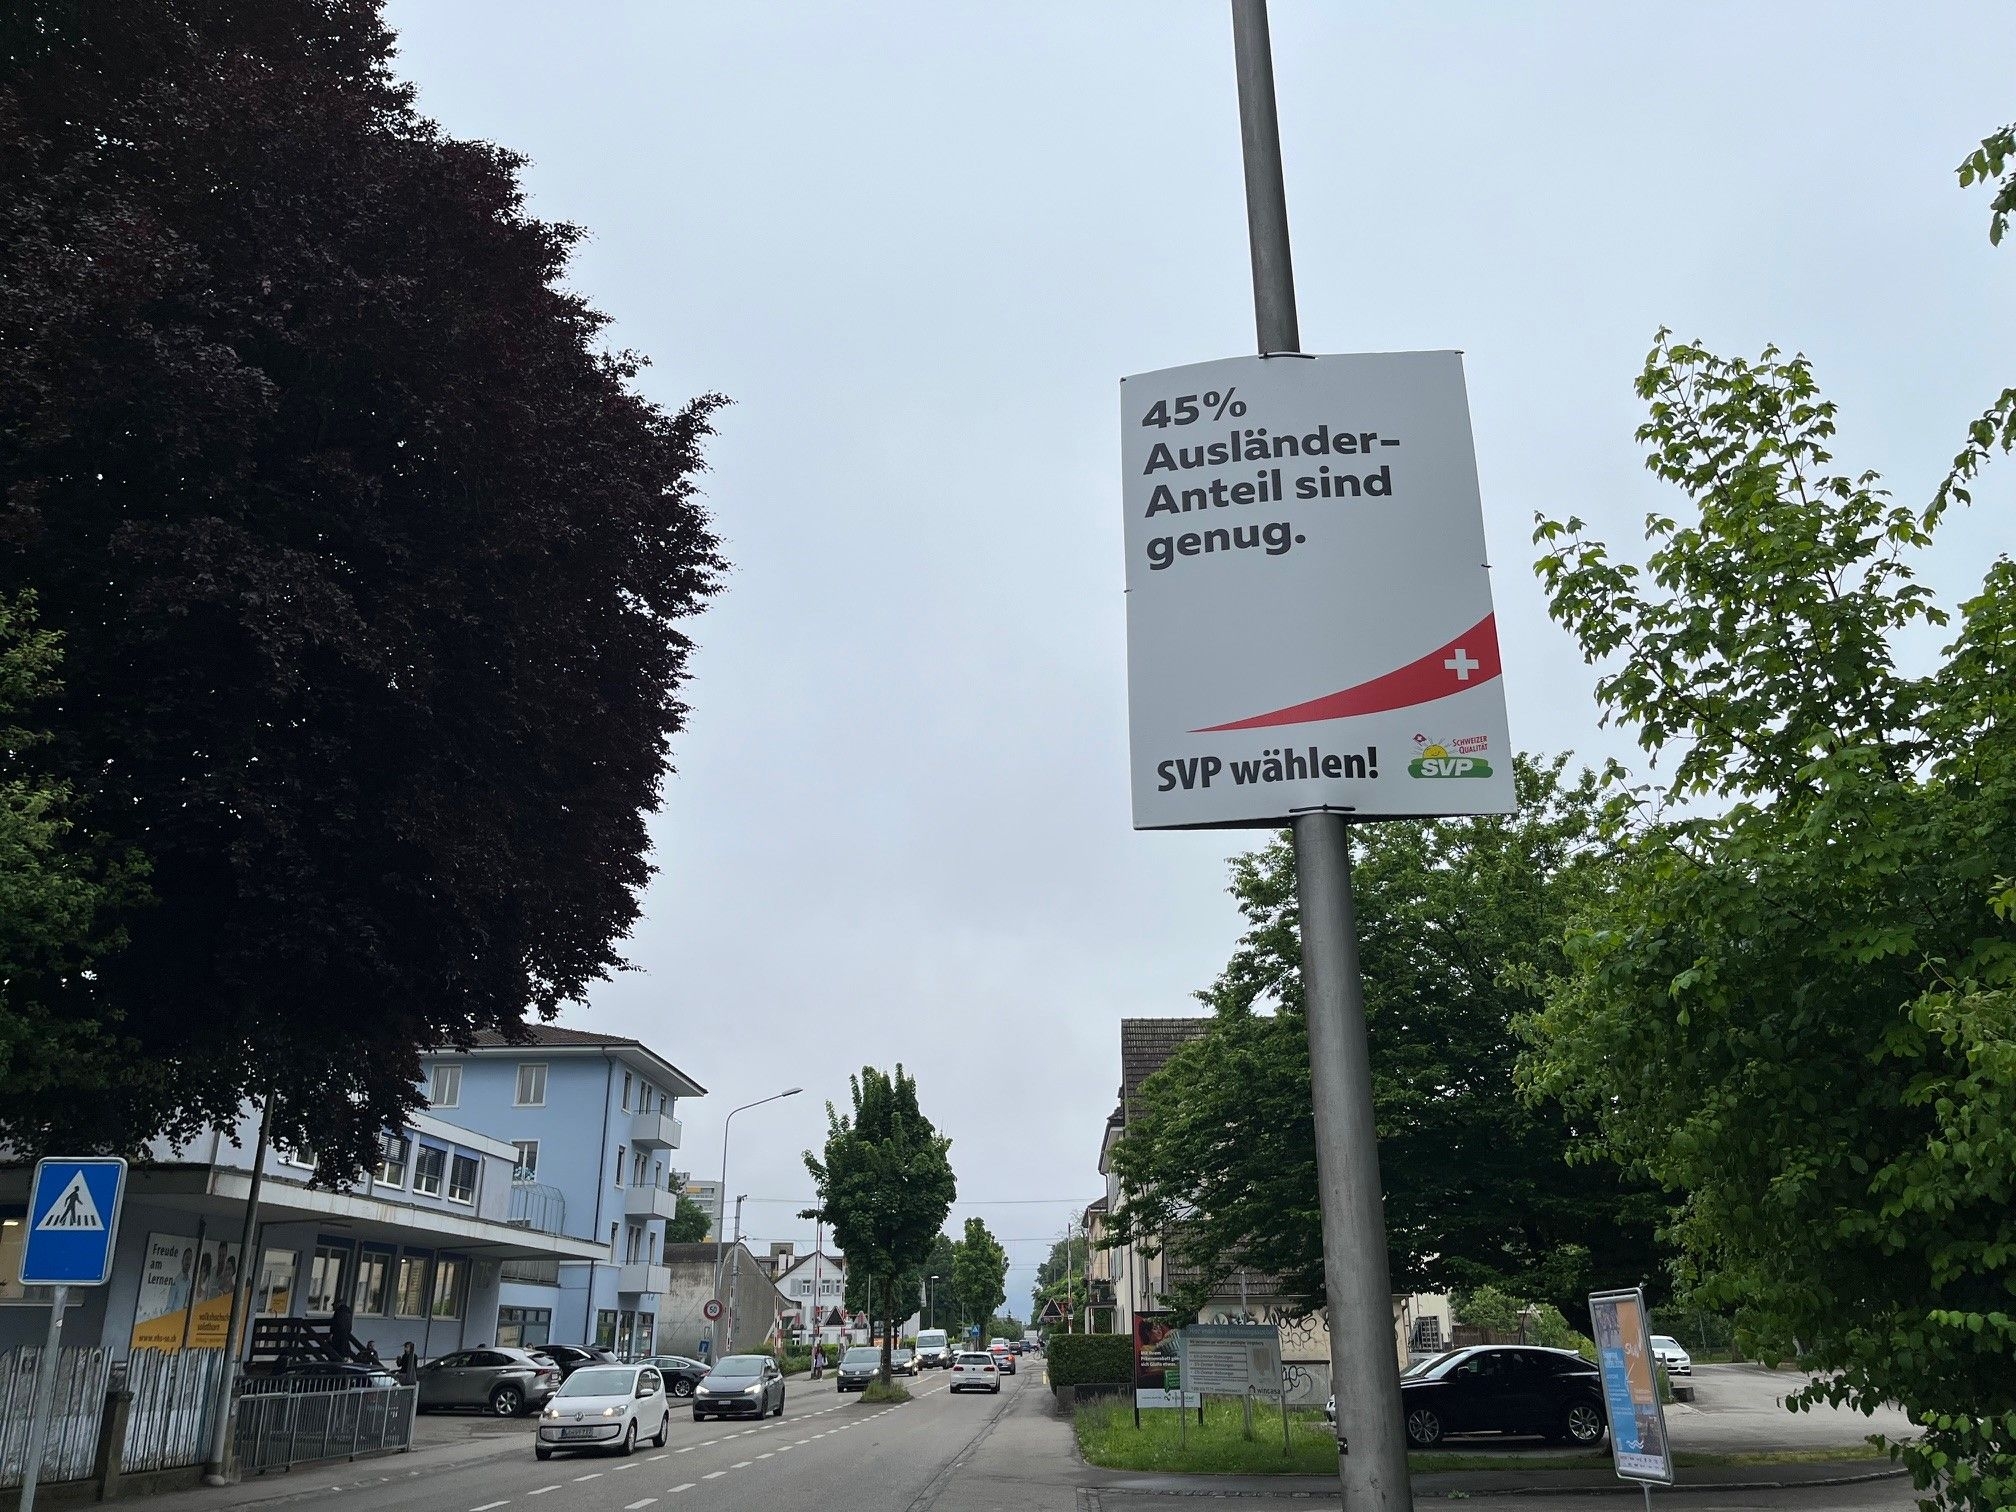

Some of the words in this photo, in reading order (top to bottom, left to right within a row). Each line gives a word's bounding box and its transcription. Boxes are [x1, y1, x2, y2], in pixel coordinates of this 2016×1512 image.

[1142, 387, 1247, 429] 45%
[1143, 425, 1400, 475] Ausländer-
[1144, 469, 1282, 518] Anteil
[1295, 465, 1393, 500] sind
[1146, 521, 1306, 571] genug.
[1452, 735, 1488, 747] SCHWEIZER
[1157, 755, 1222, 792] SVP
[1230, 746, 1378, 785] wählen!
[1420, 758, 1474, 776] SVP
[150, 1260, 162, 1269] am
[152, 1243, 179, 1258] Freude
[1256, 1387, 1281, 1395] wincasa
